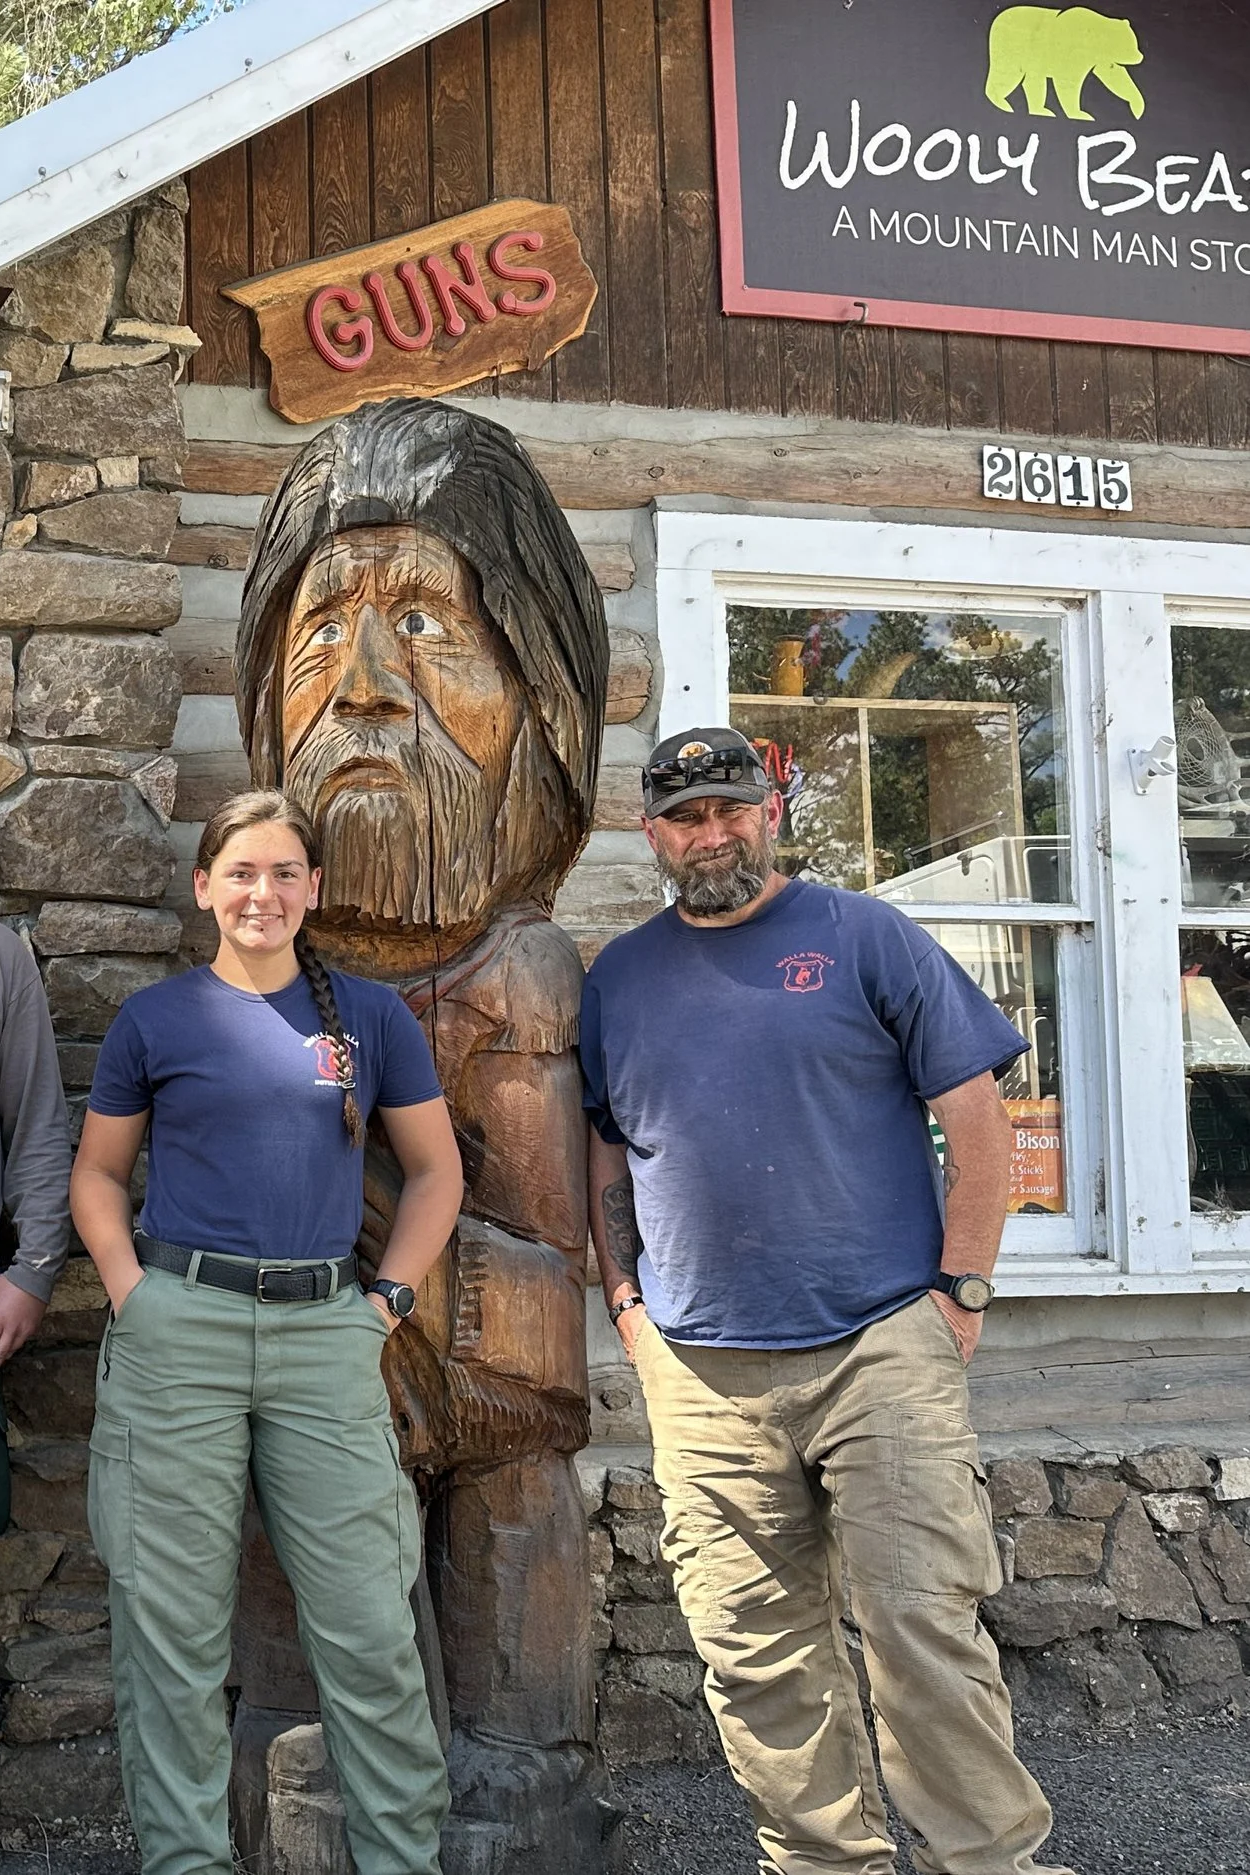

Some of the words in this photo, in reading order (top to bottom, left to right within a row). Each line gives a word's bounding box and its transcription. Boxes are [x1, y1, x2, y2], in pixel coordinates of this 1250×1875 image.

[778, 98, 1041, 197] WOOLY
[1076, 130, 1250, 217] BEA
[832, 205, 859, 239] A
[870, 208, 1080, 260] MOUNTAIN
[1093, 229, 1179, 268] MAN
[306, 231, 557, 373] GUNS
[986, 452, 1129, 505] 2615
[775, 952, 806, 968] WALLA
[806, 951, 836, 966] WALLA
[1015, 1130, 1060, 1150] Bison
[1017, 1164, 1044, 1175] Sticks
[1019, 1184, 1055, 1196] Sausage
